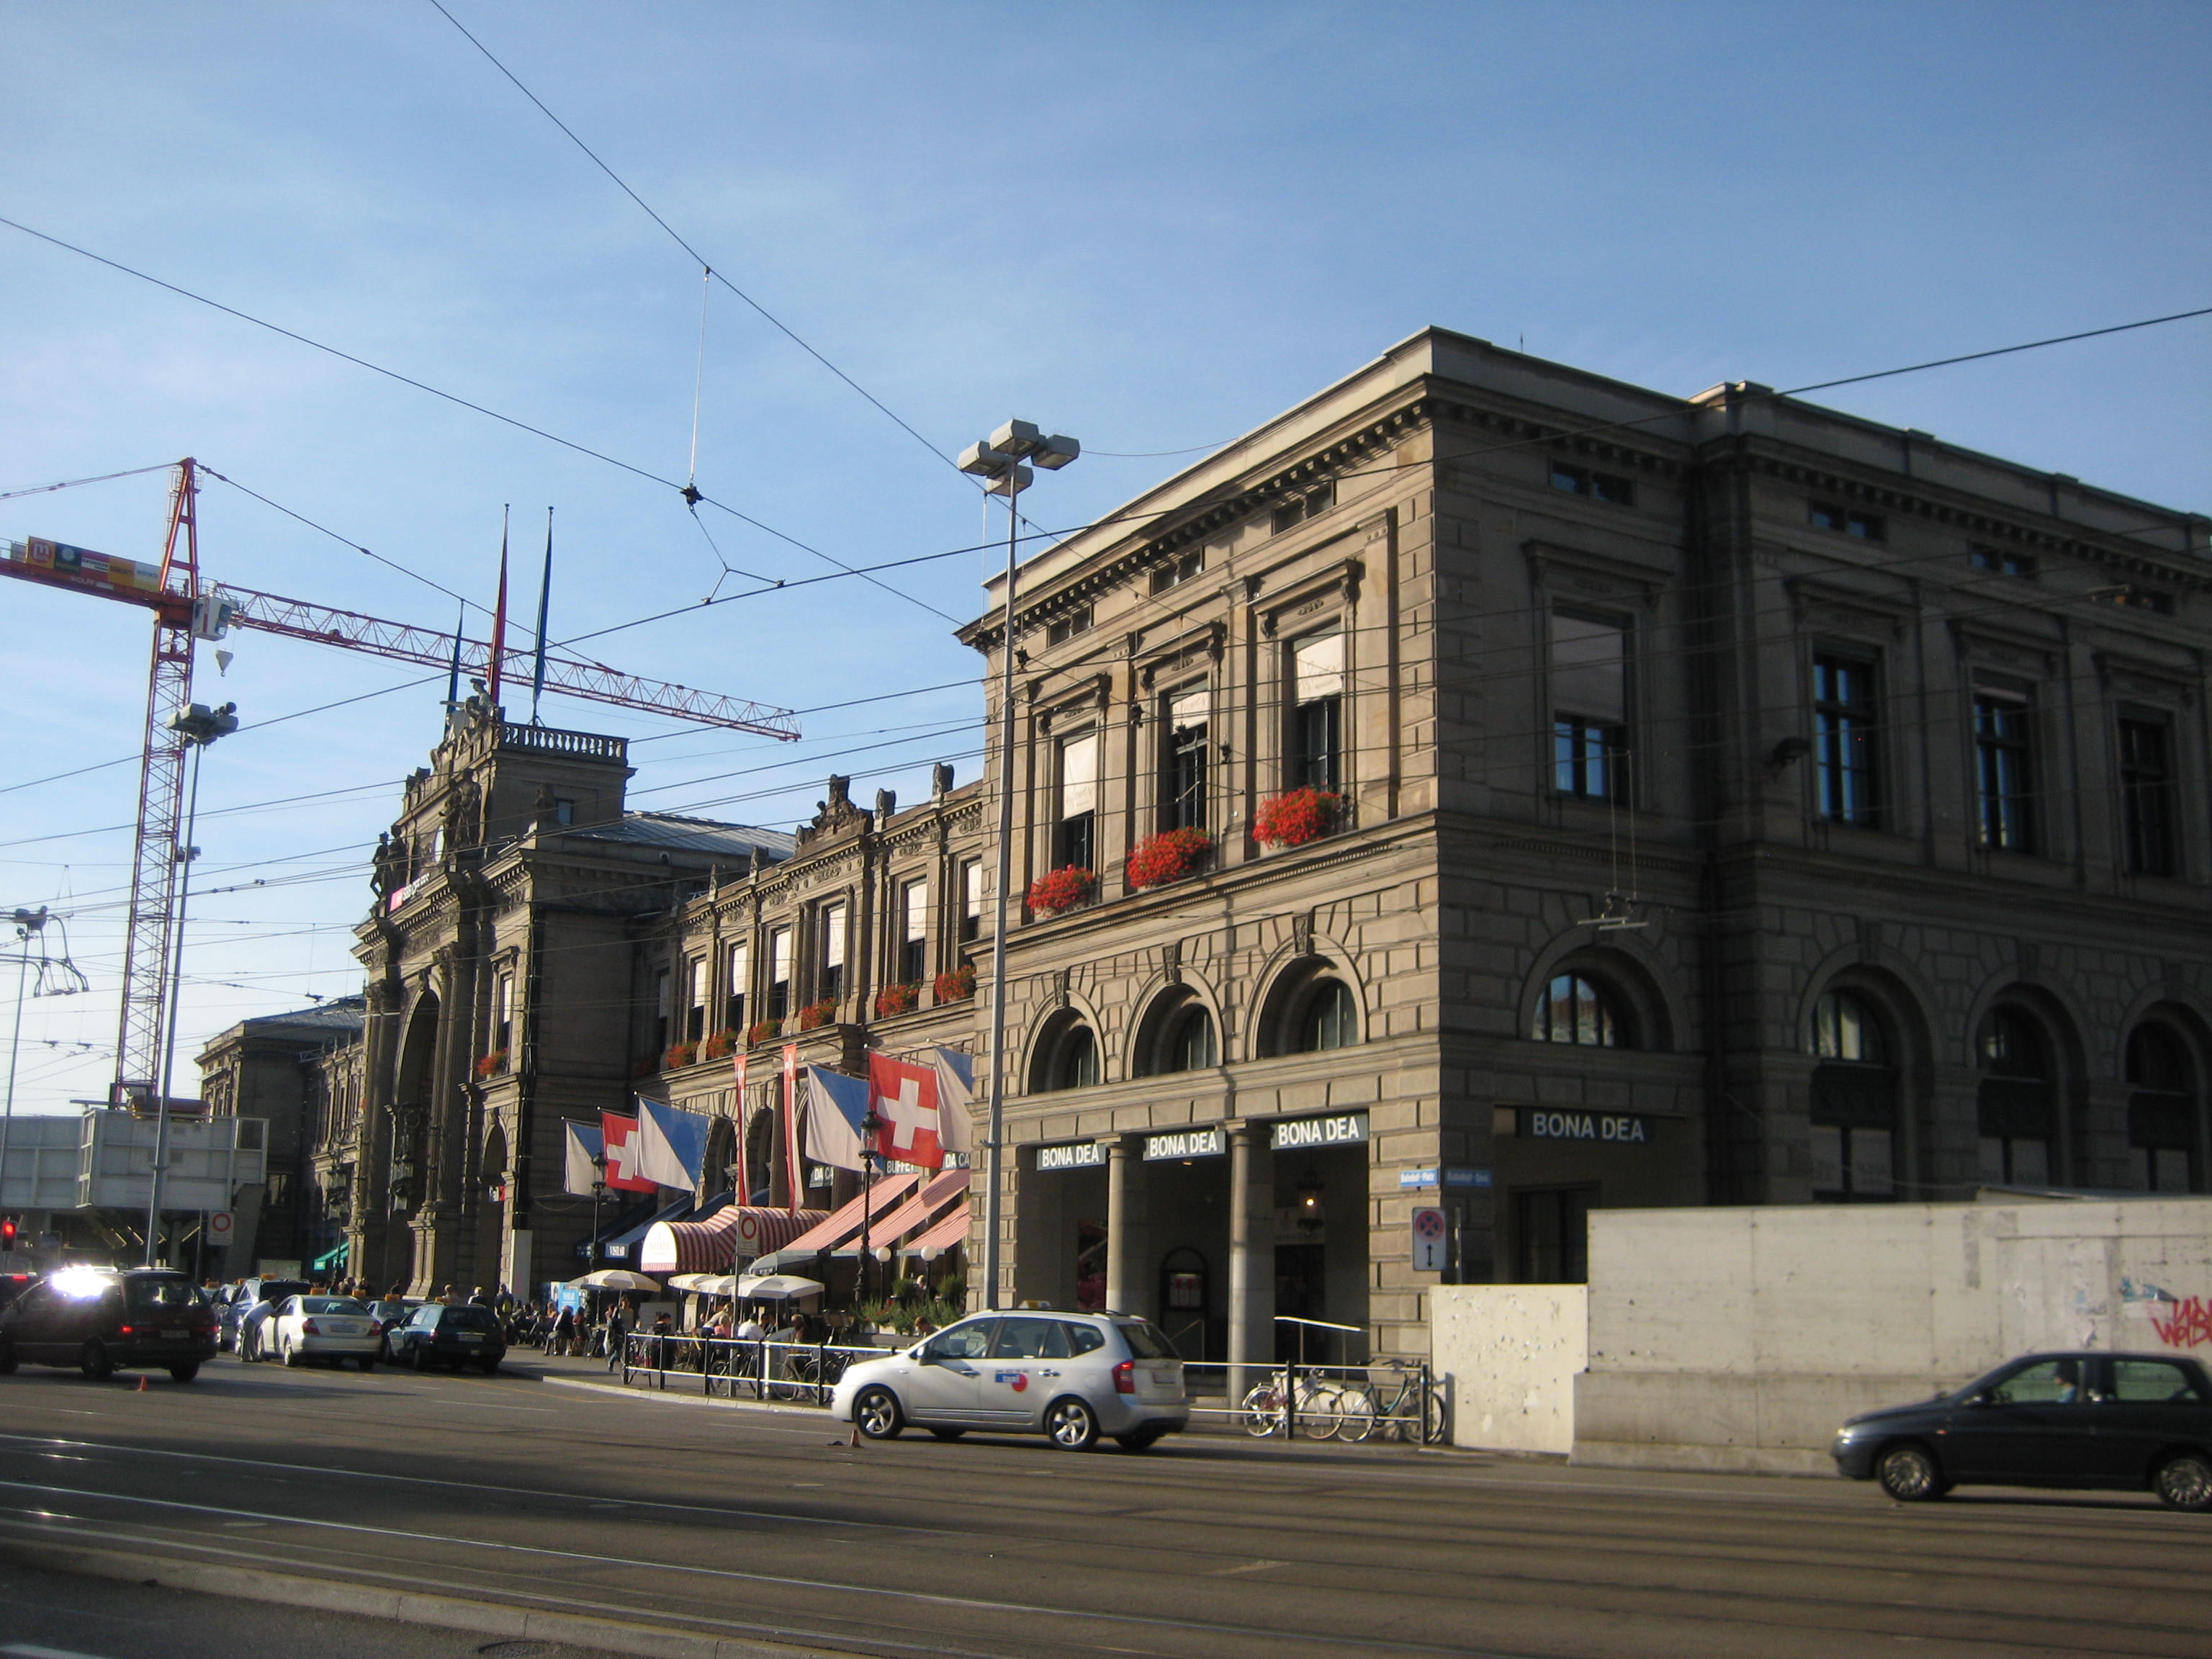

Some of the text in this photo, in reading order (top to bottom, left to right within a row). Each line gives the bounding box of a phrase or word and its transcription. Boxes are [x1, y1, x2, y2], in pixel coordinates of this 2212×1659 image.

[1278, 1116, 1359, 1146] BONA DEA
[1532, 1113, 1645, 1142] BONA DEA
[1042, 1143, 1100, 1167] BONA DEA
[1150, 1132, 1218, 1157] BONA DEA
[945, 1154, 956, 1168] DA
[814, 1167, 823, 1181] DA
